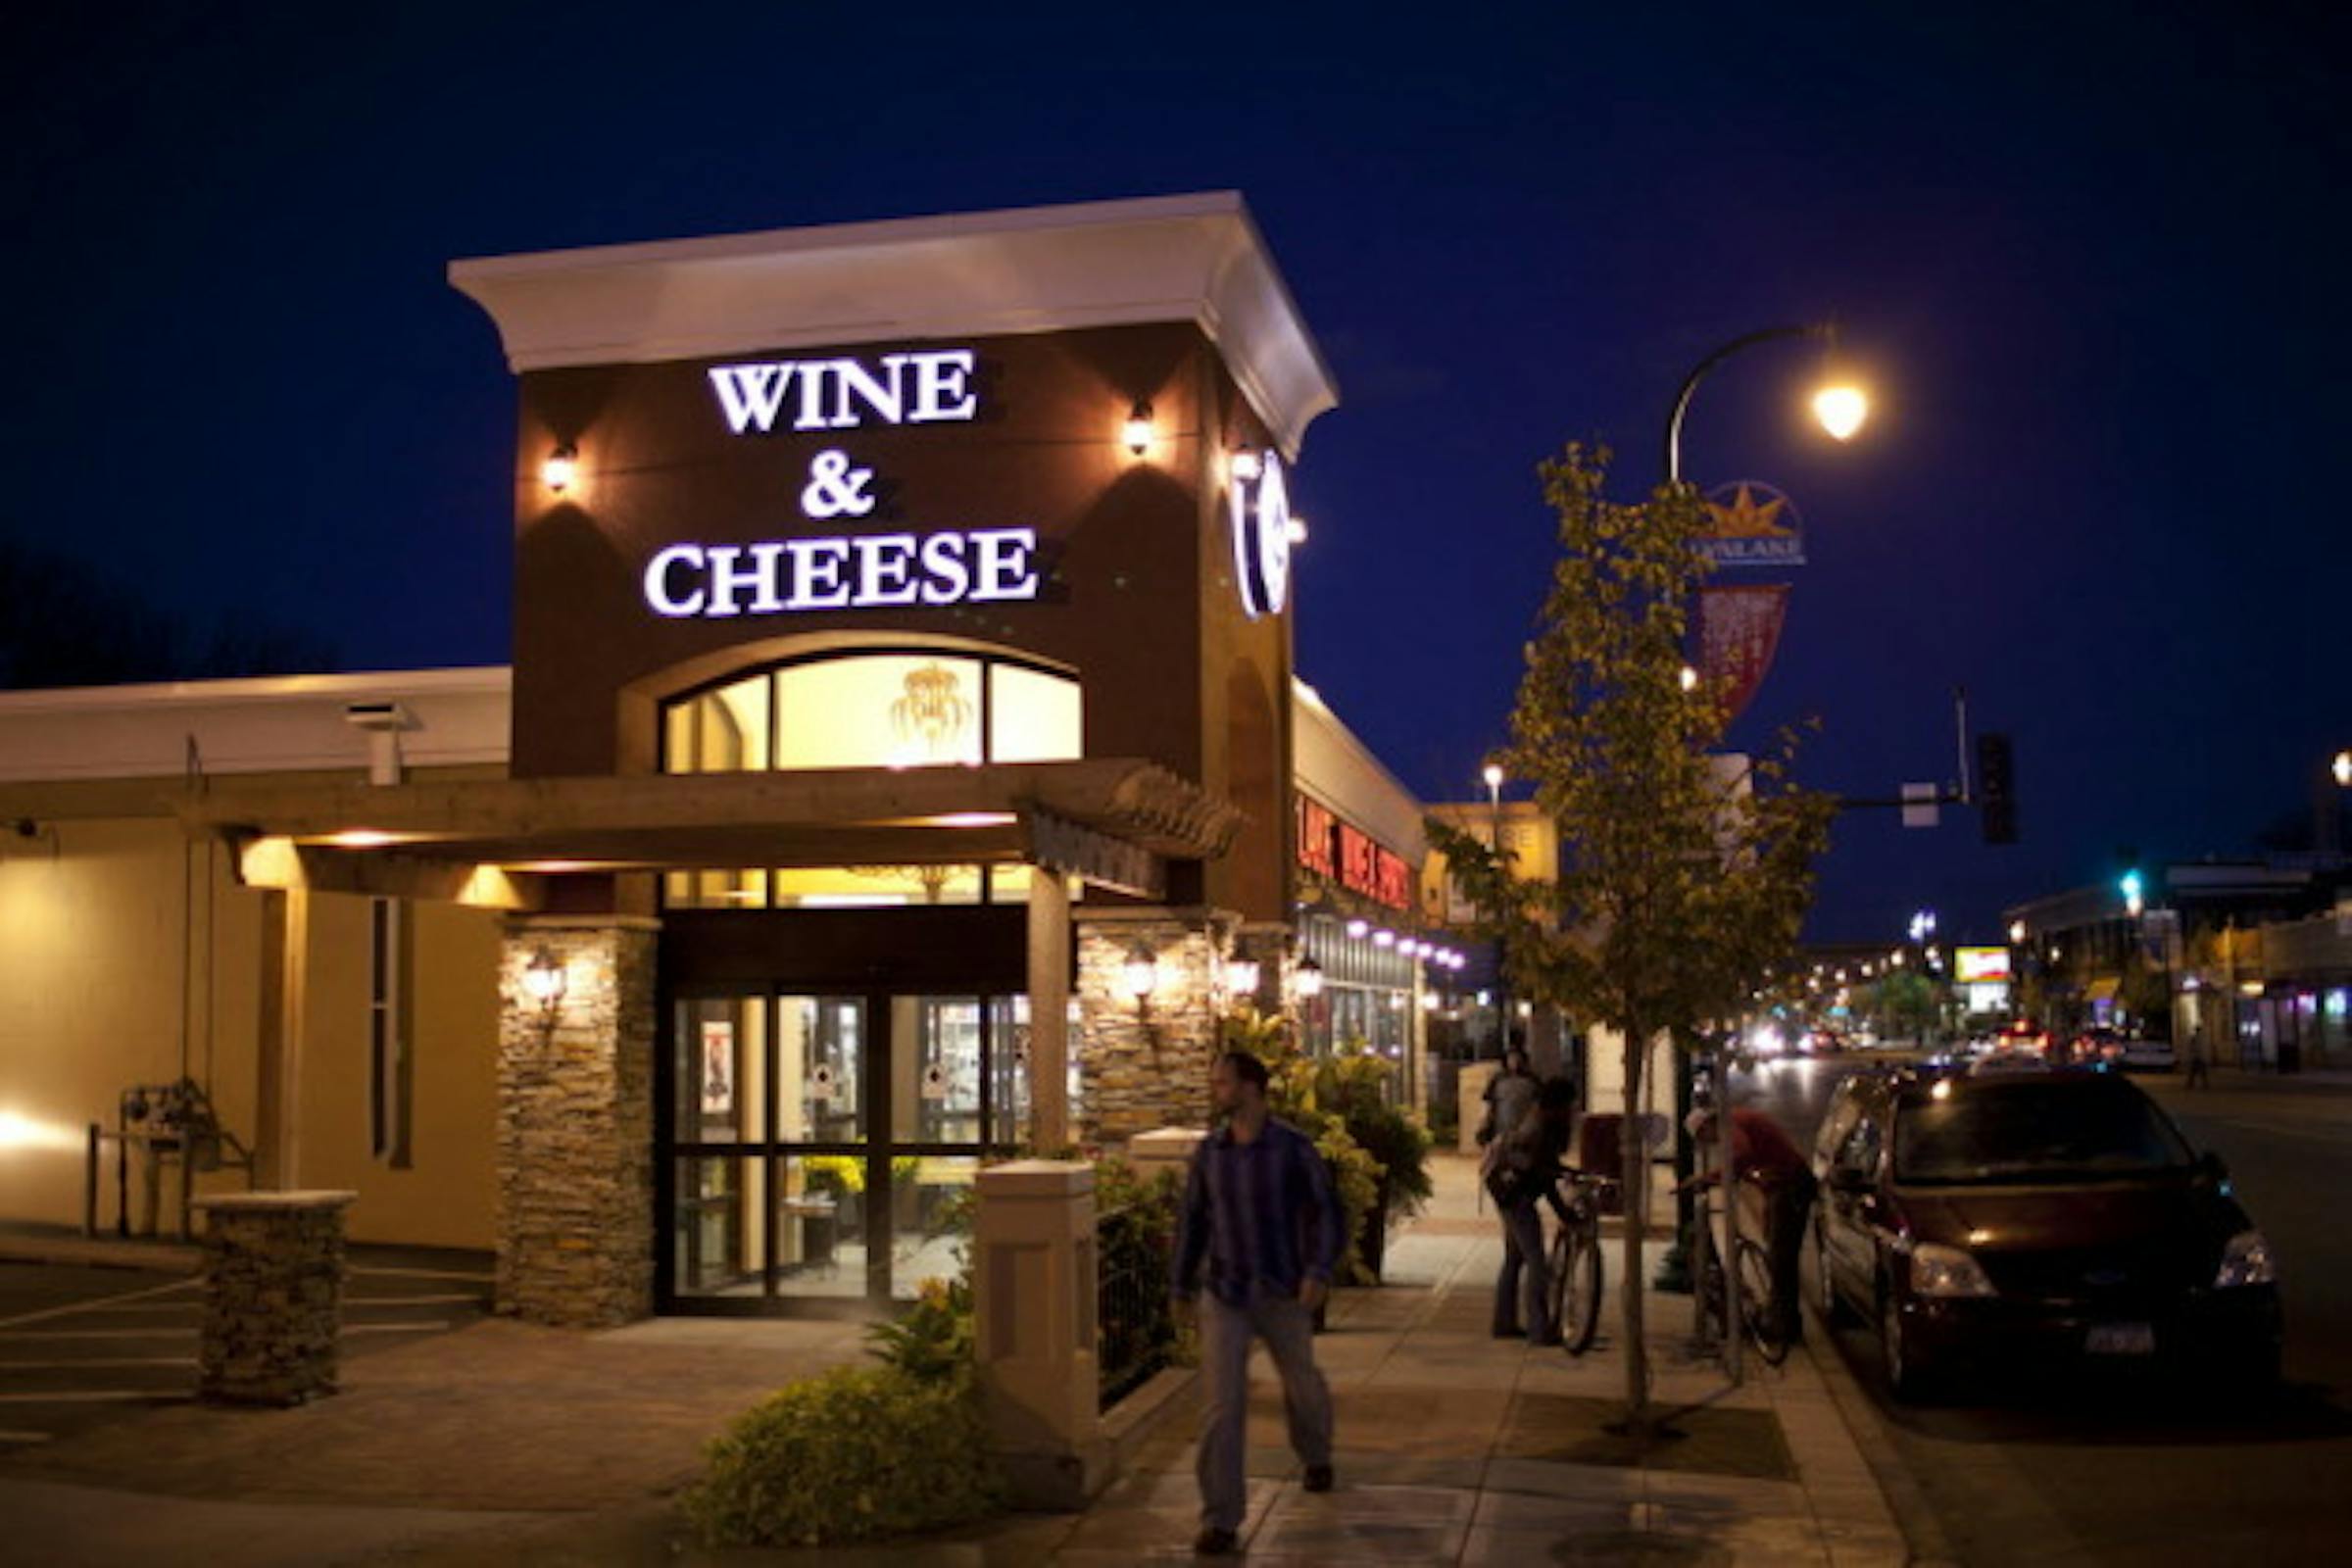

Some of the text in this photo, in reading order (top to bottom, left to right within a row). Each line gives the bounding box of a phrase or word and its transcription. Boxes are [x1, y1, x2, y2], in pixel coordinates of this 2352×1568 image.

[708, 349, 976, 433] WINE
[801, 449, 875, 517] &
[644, 527, 1038, 617] CHEESE
